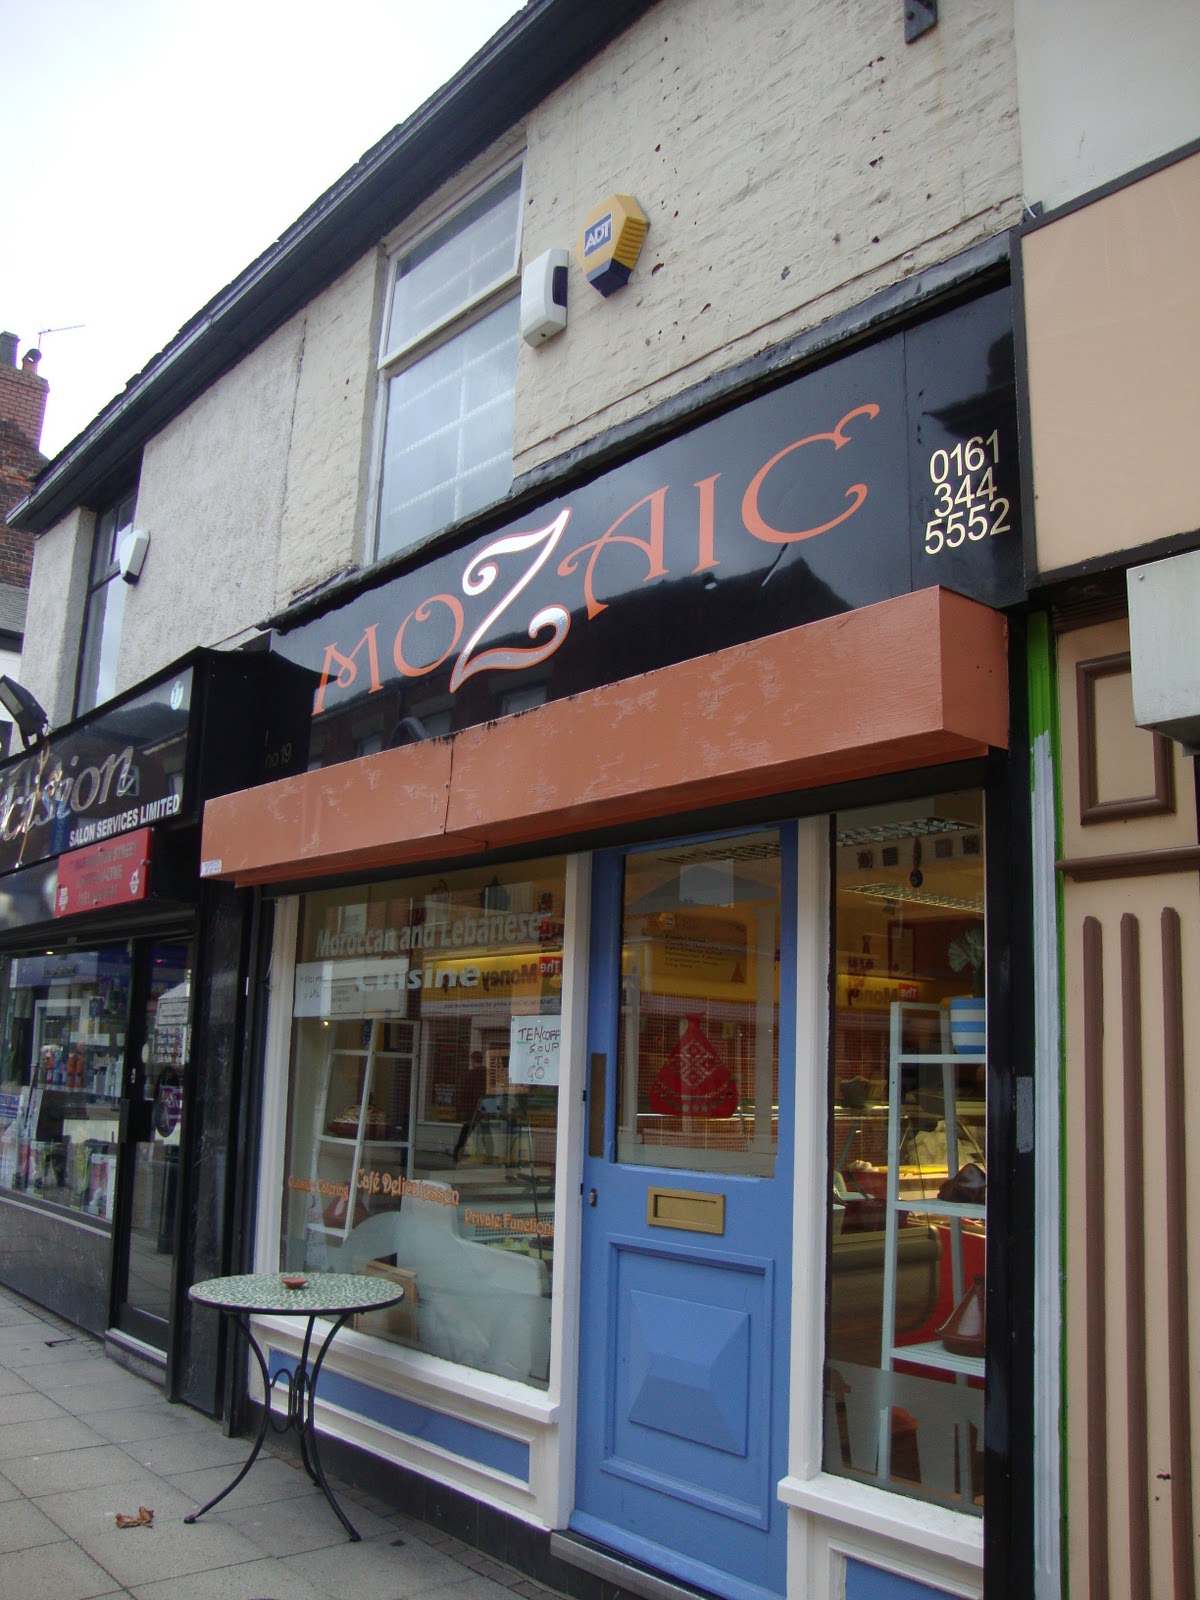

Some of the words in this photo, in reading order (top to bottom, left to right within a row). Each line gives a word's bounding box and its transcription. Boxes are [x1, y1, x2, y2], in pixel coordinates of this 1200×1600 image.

[584, 221, 612, 251] ADT
[929, 429, 999, 484] 0161
[934, 466, 998, 518] 344
[924, 498, 1011, 555] 5552
[312, 403, 880, 716] MOZAIC
[69, 823, 96, 847] SALON
[96, 807, 139, 839] SERVICES
[140, 793, 181, 824] LIMITED
[315, 927, 398, 958] Moroccan
[399, 918, 436, 950] and
[439, 911, 542, 947] Lebanese
[529, 1042, 560, 1054] SOUP
[527, 1065, 546, 1083] GO
[356, 1168, 380, 1197] Café
[382, 1173, 460, 1208] Delicatessen
[464, 1208, 501, 1231] Private
